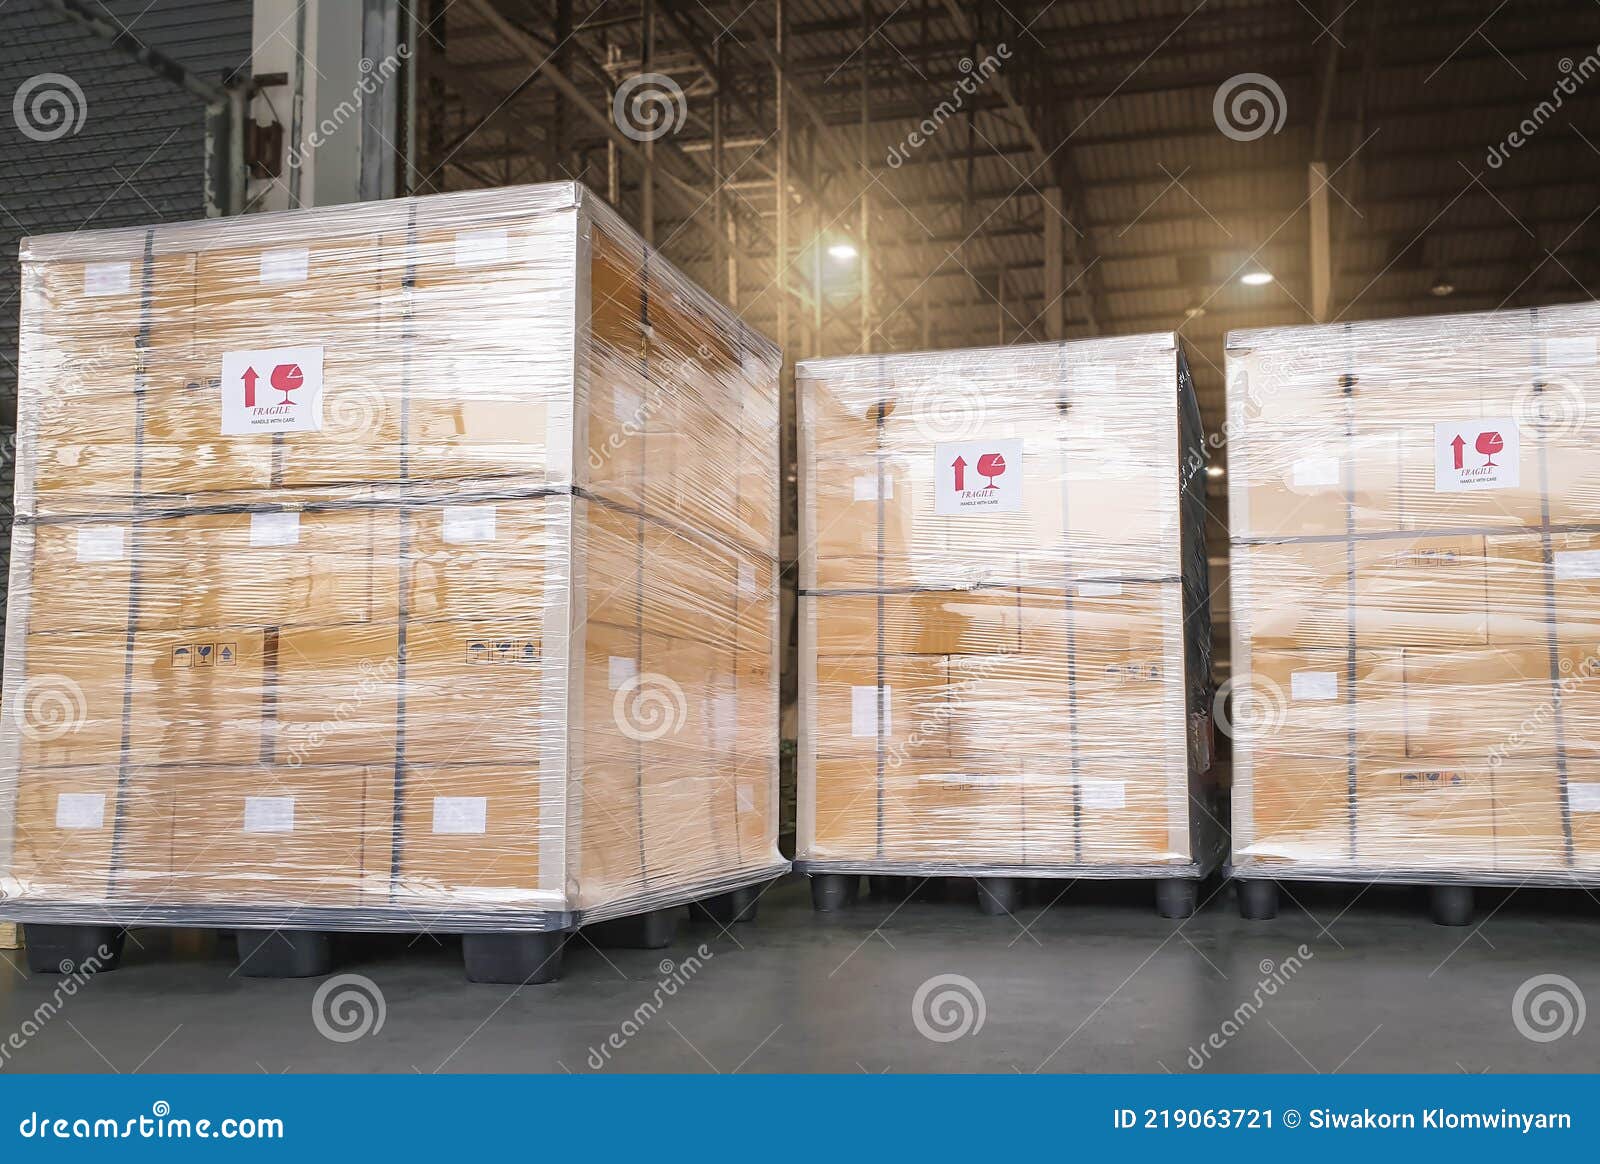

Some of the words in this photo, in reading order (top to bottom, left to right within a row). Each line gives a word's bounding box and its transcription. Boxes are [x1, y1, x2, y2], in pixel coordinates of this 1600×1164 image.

[253, 406, 291, 416] FRAGILE
[1461, 467, 1494, 476] FRAGILE
[961, 490, 994, 498] FRAGILE
